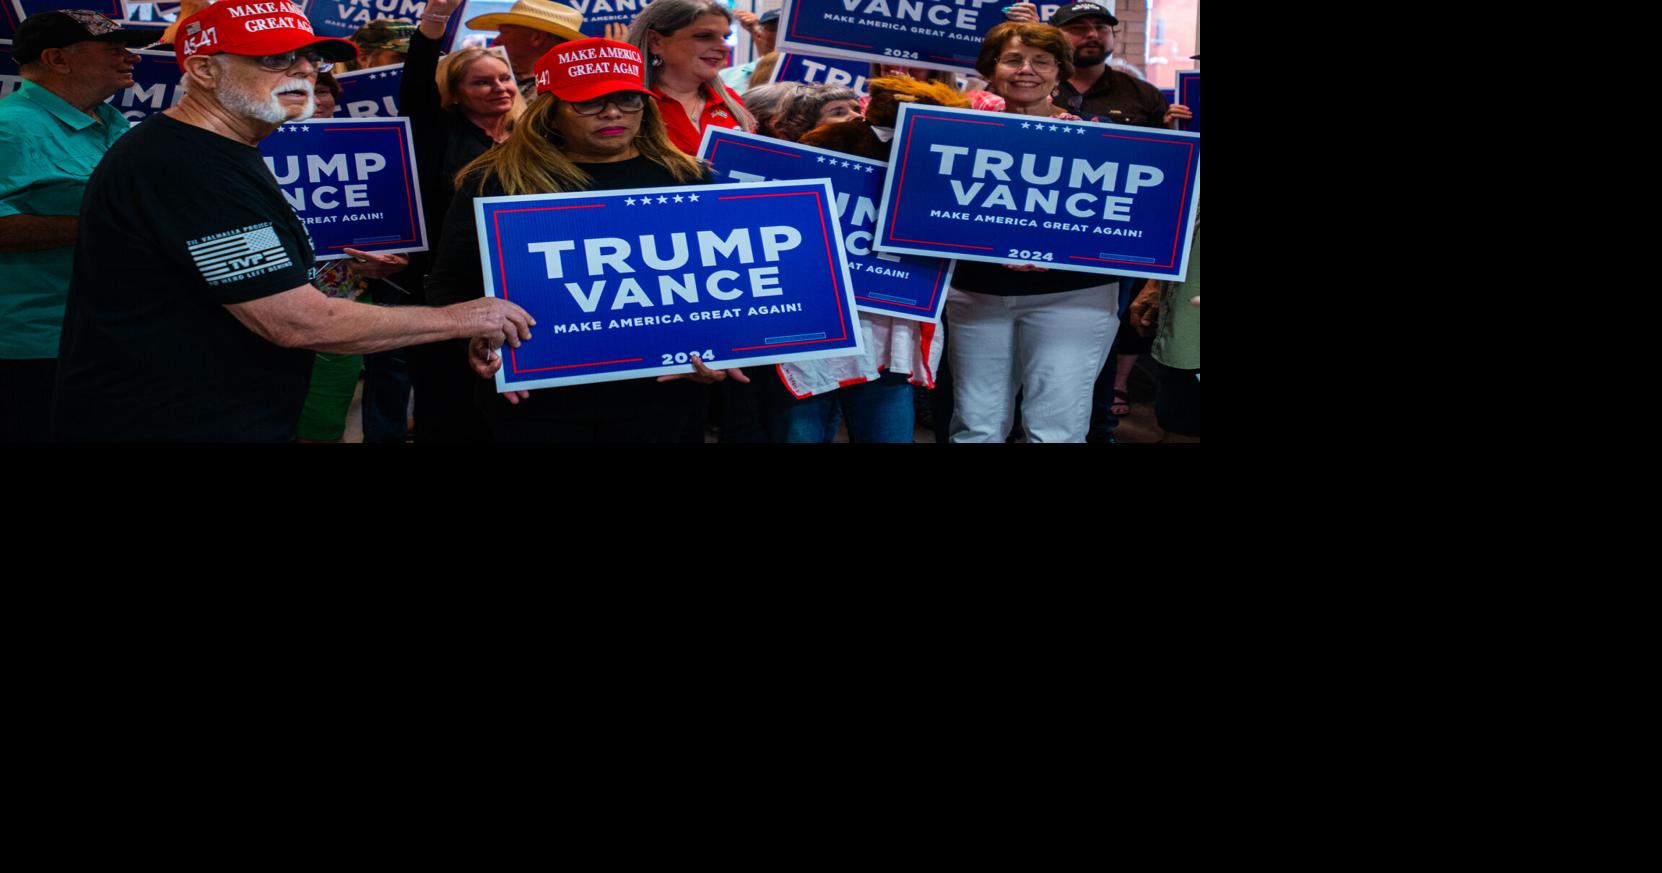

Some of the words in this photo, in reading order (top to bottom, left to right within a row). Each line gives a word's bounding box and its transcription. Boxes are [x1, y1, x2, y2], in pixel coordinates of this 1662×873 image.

[227, 2, 279, 18] MAKE
[591, 14, 629, 22] AMERICA
[840, 0, 980, 31] VANCE
[244, 17, 297, 32] GREAT
[824, 13, 855, 24] MAKE
[858, 19, 907, 32] AMERICA
[910, 26, 945, 38] GREAT
[183, 26, 218, 55] 45-47
[883, 48, 919, 60] 2024
[558, 48, 598, 64] MAKE
[599, 46, 642, 64] AMERICA
[568, 62, 610, 78] GREAT
[263, 152, 387, 185] UMP
[929, 143, 1166, 195] TRUMP
[280, 183, 370, 212] NCE
[950, 179, 1135, 223] VANCE
[342, 212, 384, 222] AGAIN!
[930, 209, 971, 221] MAKE
[973, 214, 1038, 228] AMERICA
[1042, 220, 1089, 233] GREAT
[1092, 225, 1144, 238] AGAIN!
[527, 225, 803, 280] TRUMP
[1007, 248, 1055, 262] 2024
[866, 263, 909, 280] AGAIN!
[564, 266, 784, 313] VANCE
[553, 320, 603, 334] MAKE
[608, 313, 684, 329] AMERICA
[689, 307, 742, 323] GREAT
[747, 302, 803, 317] AGAIN!
